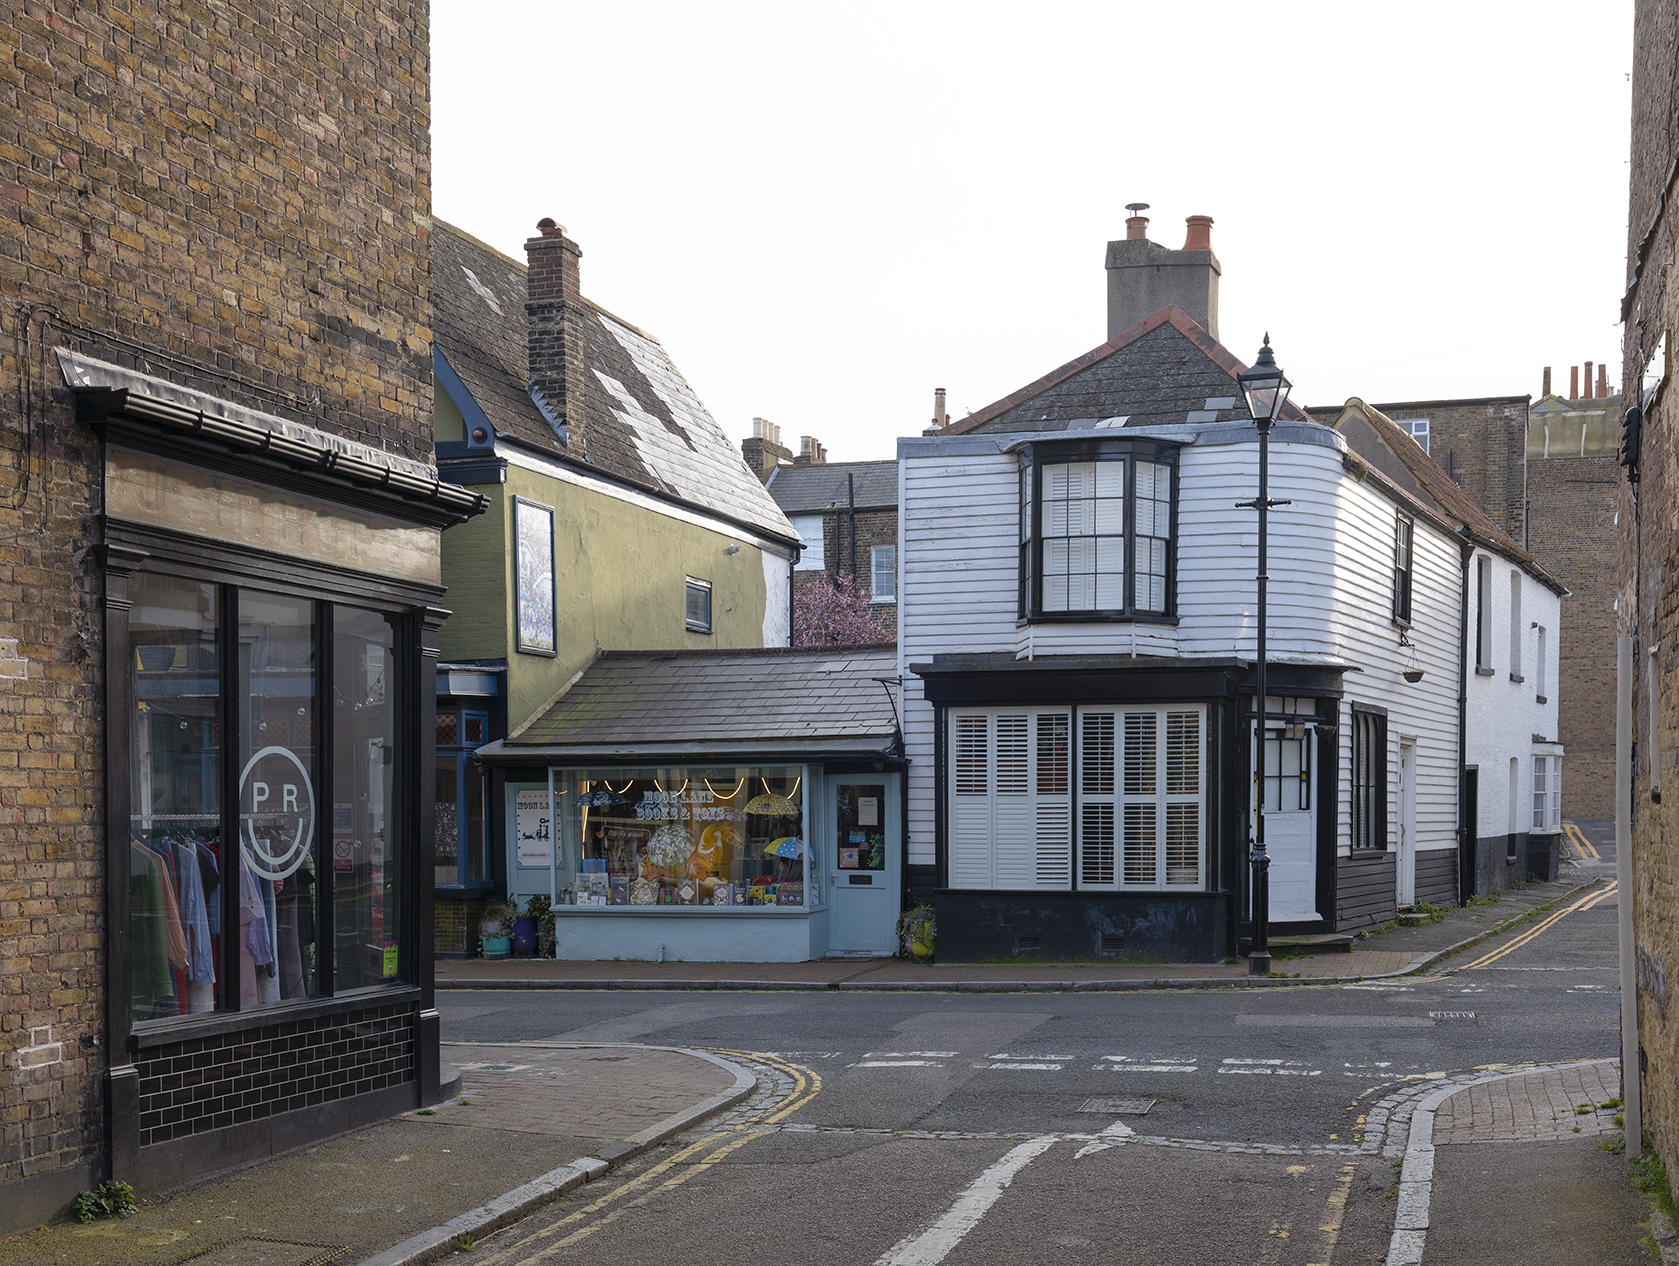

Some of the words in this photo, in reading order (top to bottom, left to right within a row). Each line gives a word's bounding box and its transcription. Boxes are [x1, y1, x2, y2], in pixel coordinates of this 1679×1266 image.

[643, 790, 678, 804] MOON
[680, 790, 715, 804] LANE
[517, 802, 538, 810] MOON
[539, 802, 561, 810] LAE
[635, 807, 679, 821] BOOKS
[680, 808, 691, 820] &
[692, 807, 726, 821] TOYS
